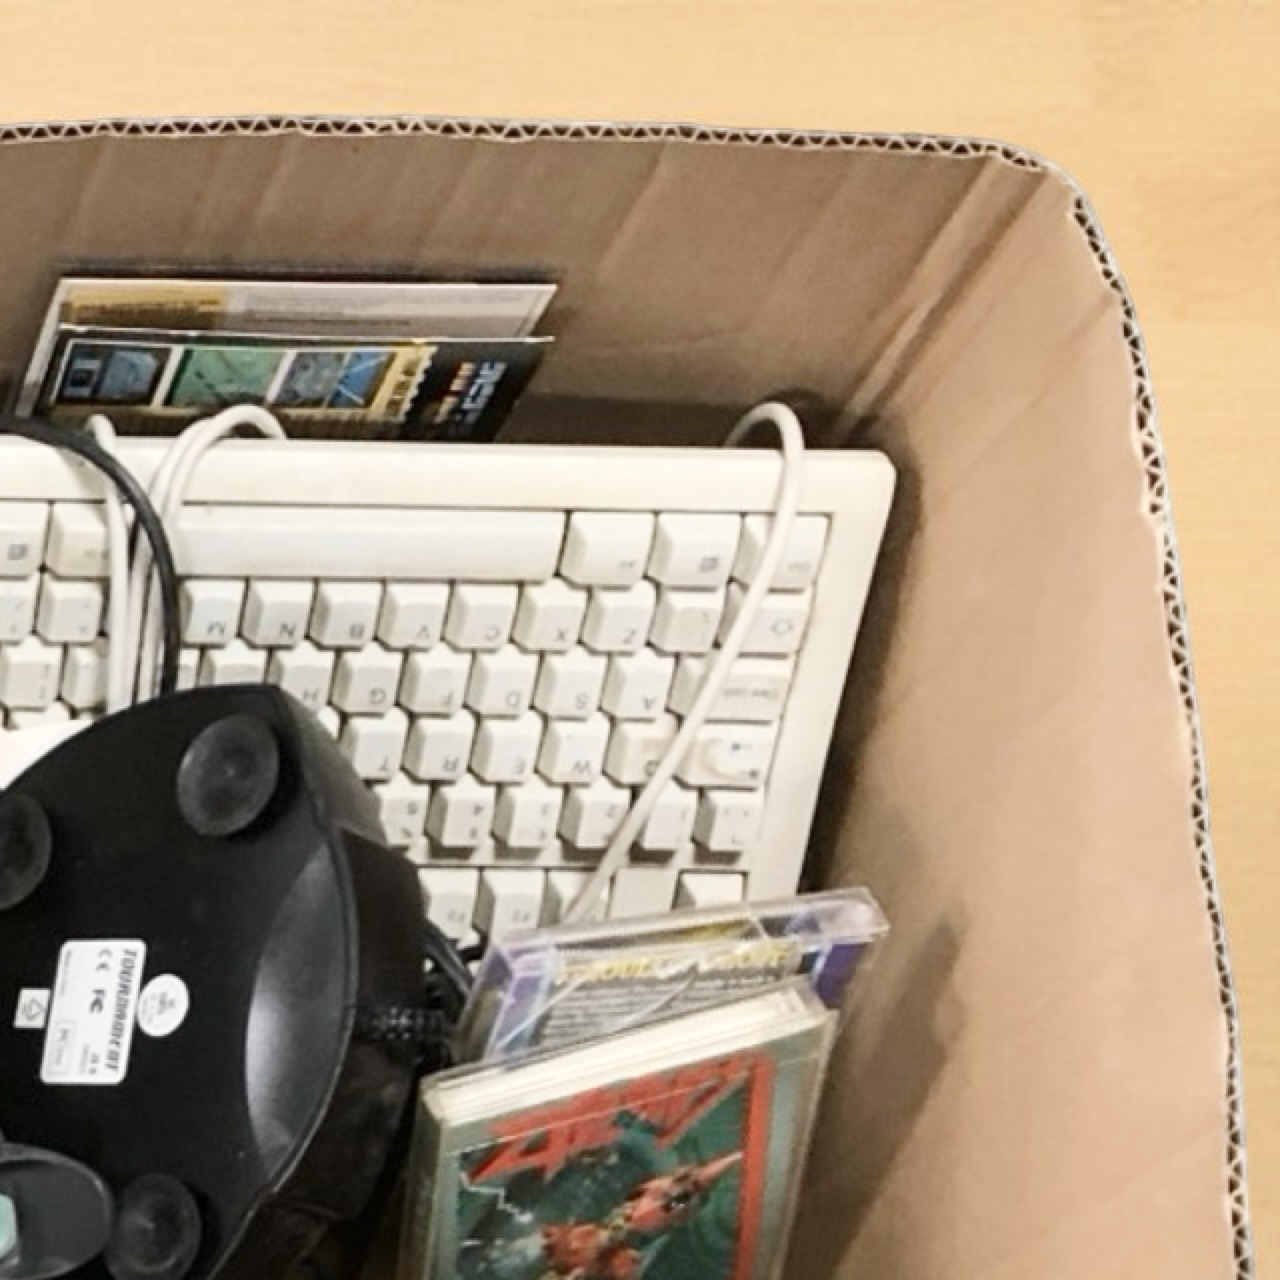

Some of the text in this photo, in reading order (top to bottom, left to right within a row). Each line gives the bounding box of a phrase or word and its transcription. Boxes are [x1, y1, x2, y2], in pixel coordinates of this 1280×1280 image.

[555, 628, 569, 644] X
[369, 689, 386, 705] G
[642, 697, 658, 711] A
[444, 758, 459, 773] R
[514, 759, 527, 775] E
[573, 760, 591, 775] W
